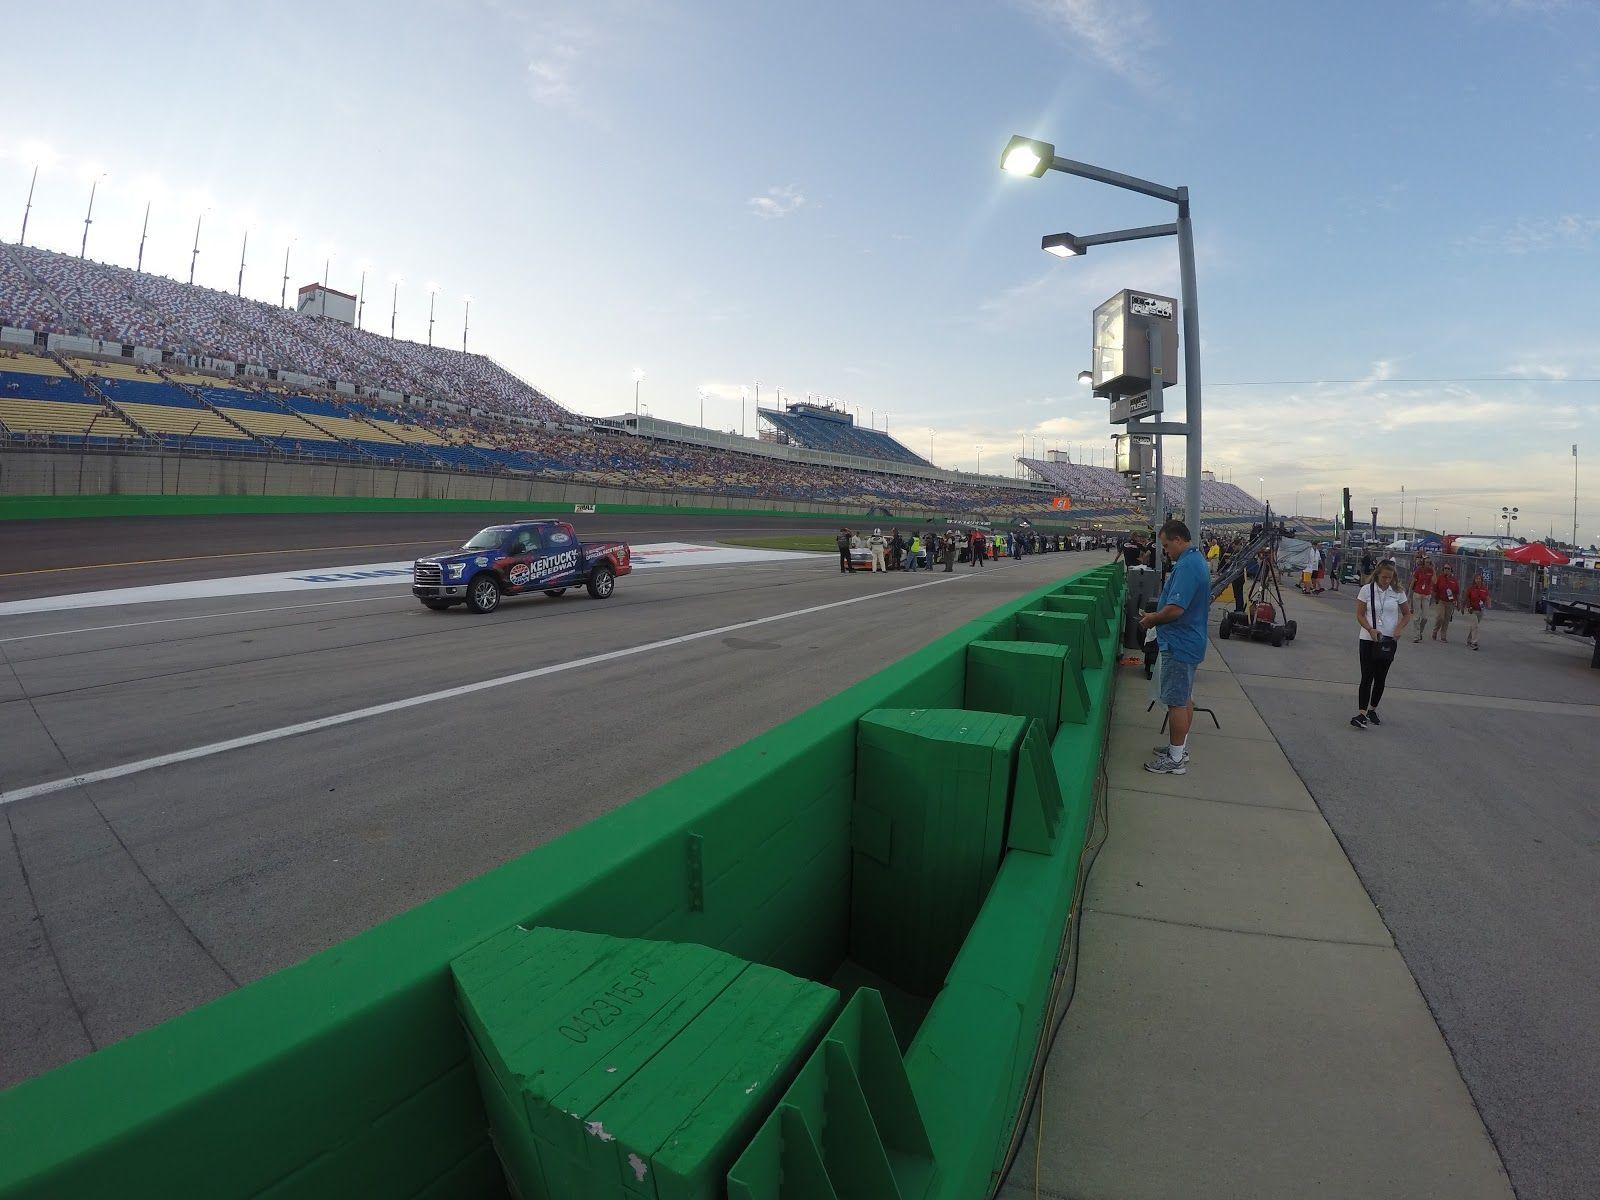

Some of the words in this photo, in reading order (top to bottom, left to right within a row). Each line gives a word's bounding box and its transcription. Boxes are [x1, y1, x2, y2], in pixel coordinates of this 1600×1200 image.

[1133, 303, 1169, 317] musco
[1131, 399, 1147, 411] musco
[530, 549, 578, 573] KENTUCKY
[530, 560, 577, 580] SPEEDWAY
[558, 968, 656, 1043] 042315-P
